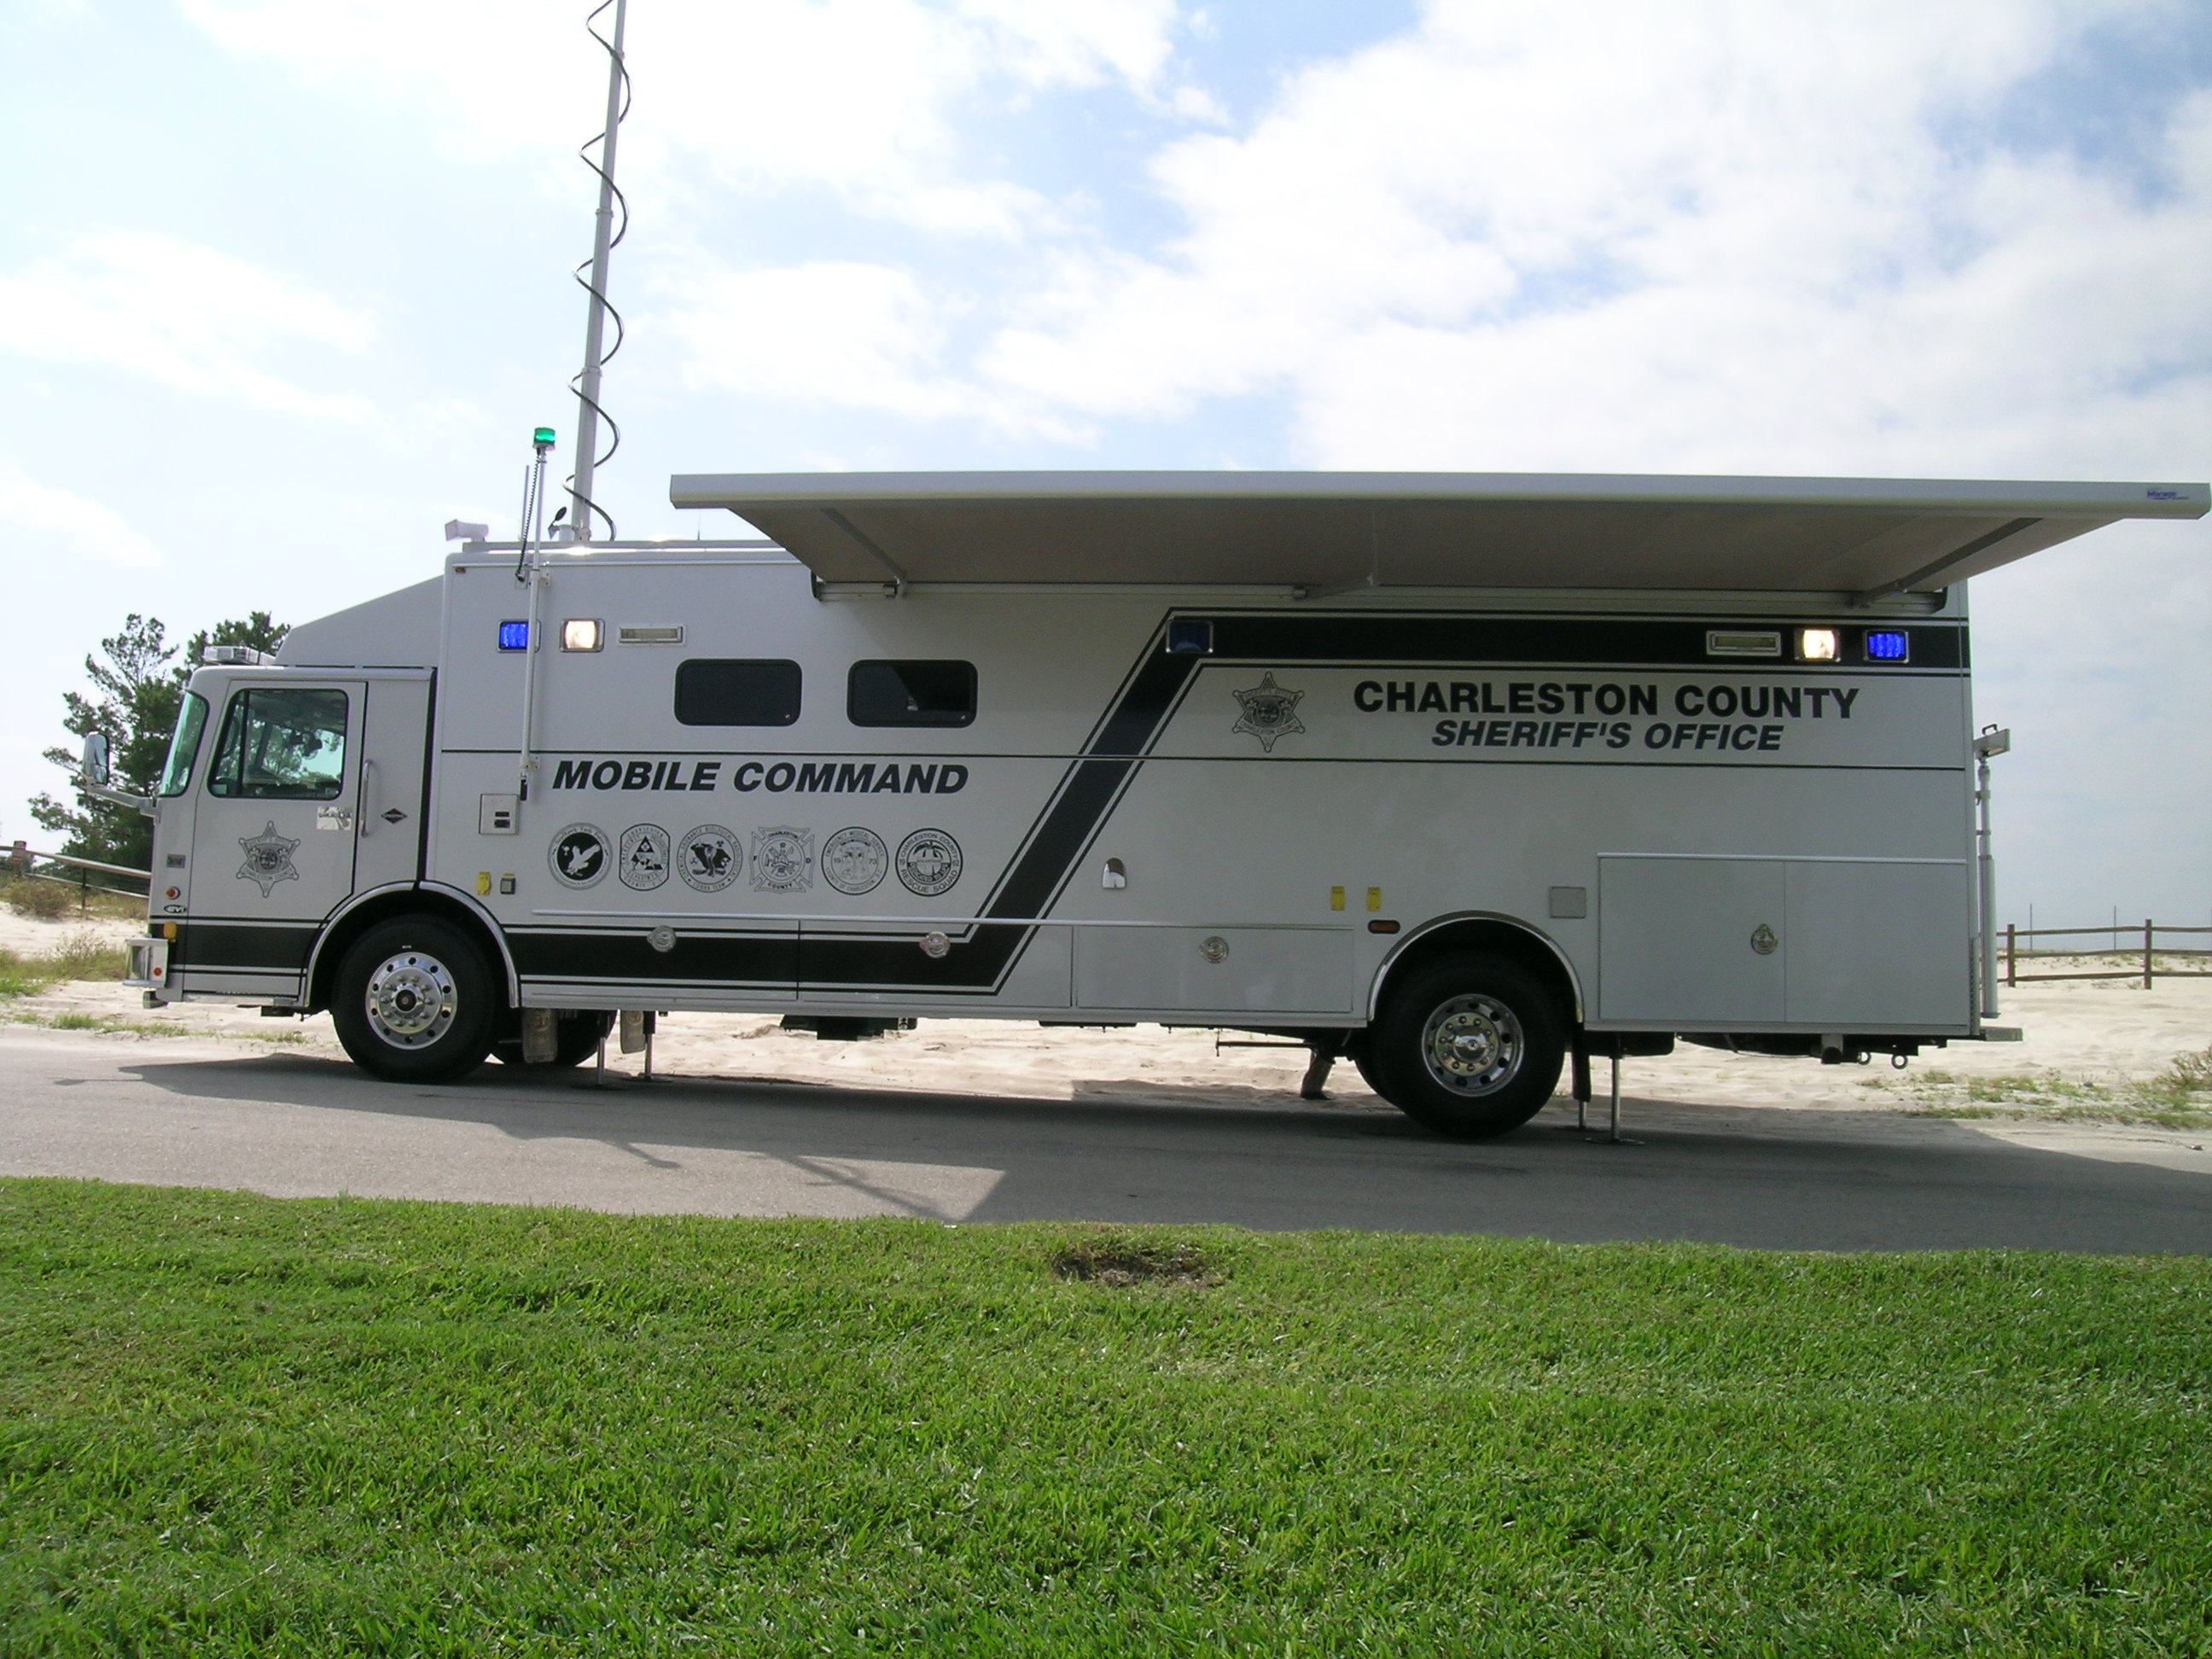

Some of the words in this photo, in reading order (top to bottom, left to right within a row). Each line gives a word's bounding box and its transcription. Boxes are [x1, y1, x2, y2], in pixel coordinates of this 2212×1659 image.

[1353, 680, 1658, 716] CHARLESTON
[1674, 684, 1860, 719] COUNTY
[1431, 720, 1632, 749] SHERIFF'S
[1644, 723, 1784, 751] OFFICE
[552, 760, 722, 791] MOBILE
[733, 761, 969, 795] COMMAND
[900, 832, 938, 858] CHARLESTON
[939, 835, 958, 858] COUNTY
[900, 868, 929, 893] RESCUE
[933, 870, 958, 893] SQUAD
